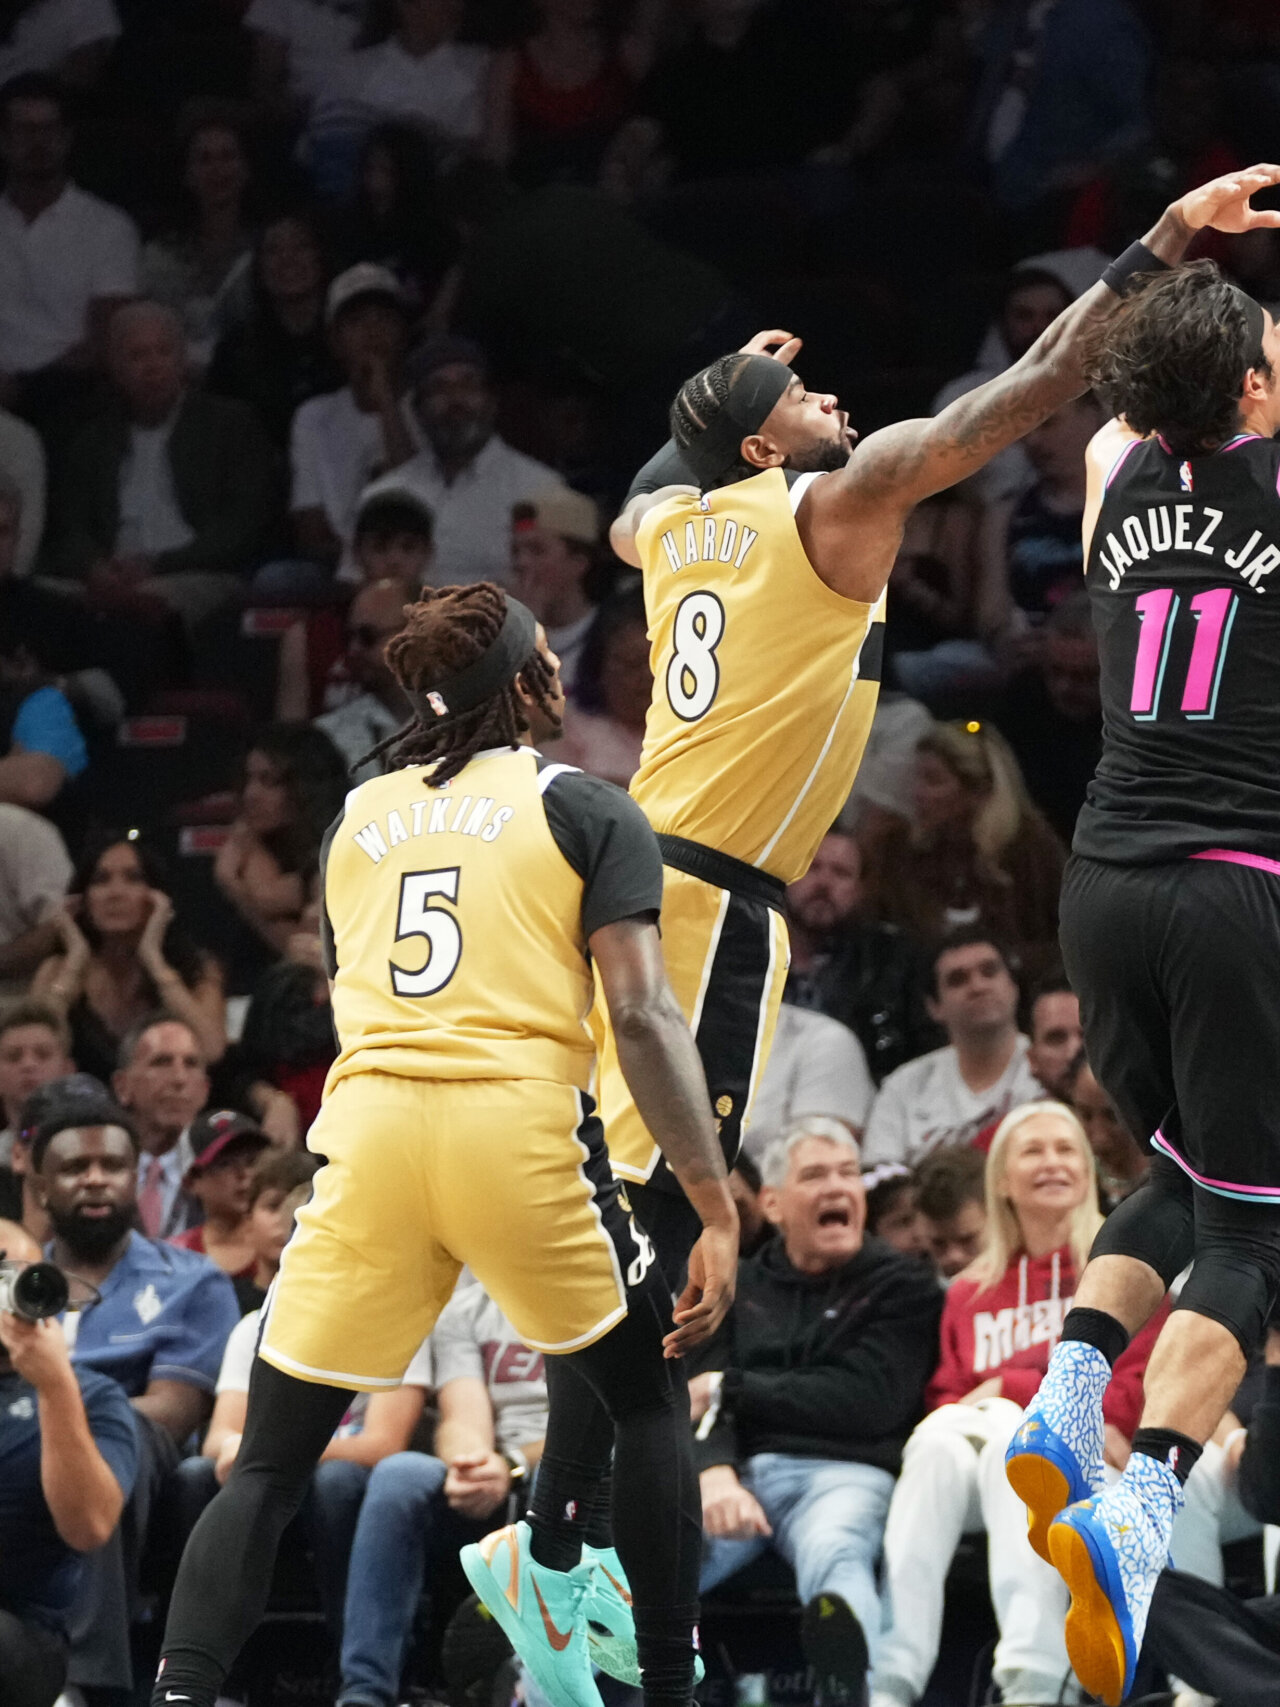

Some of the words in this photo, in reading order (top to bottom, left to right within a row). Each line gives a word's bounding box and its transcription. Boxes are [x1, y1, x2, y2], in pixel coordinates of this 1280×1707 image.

[661, 517, 759, 574] HARDY
[1099, 504, 1224, 591] JAQUEZ
[665, 589, 726, 723] 8
[1130, 588, 1240, 722] 11
[353, 796, 515, 864] WATKINS
[388, 865, 463, 998] 5
